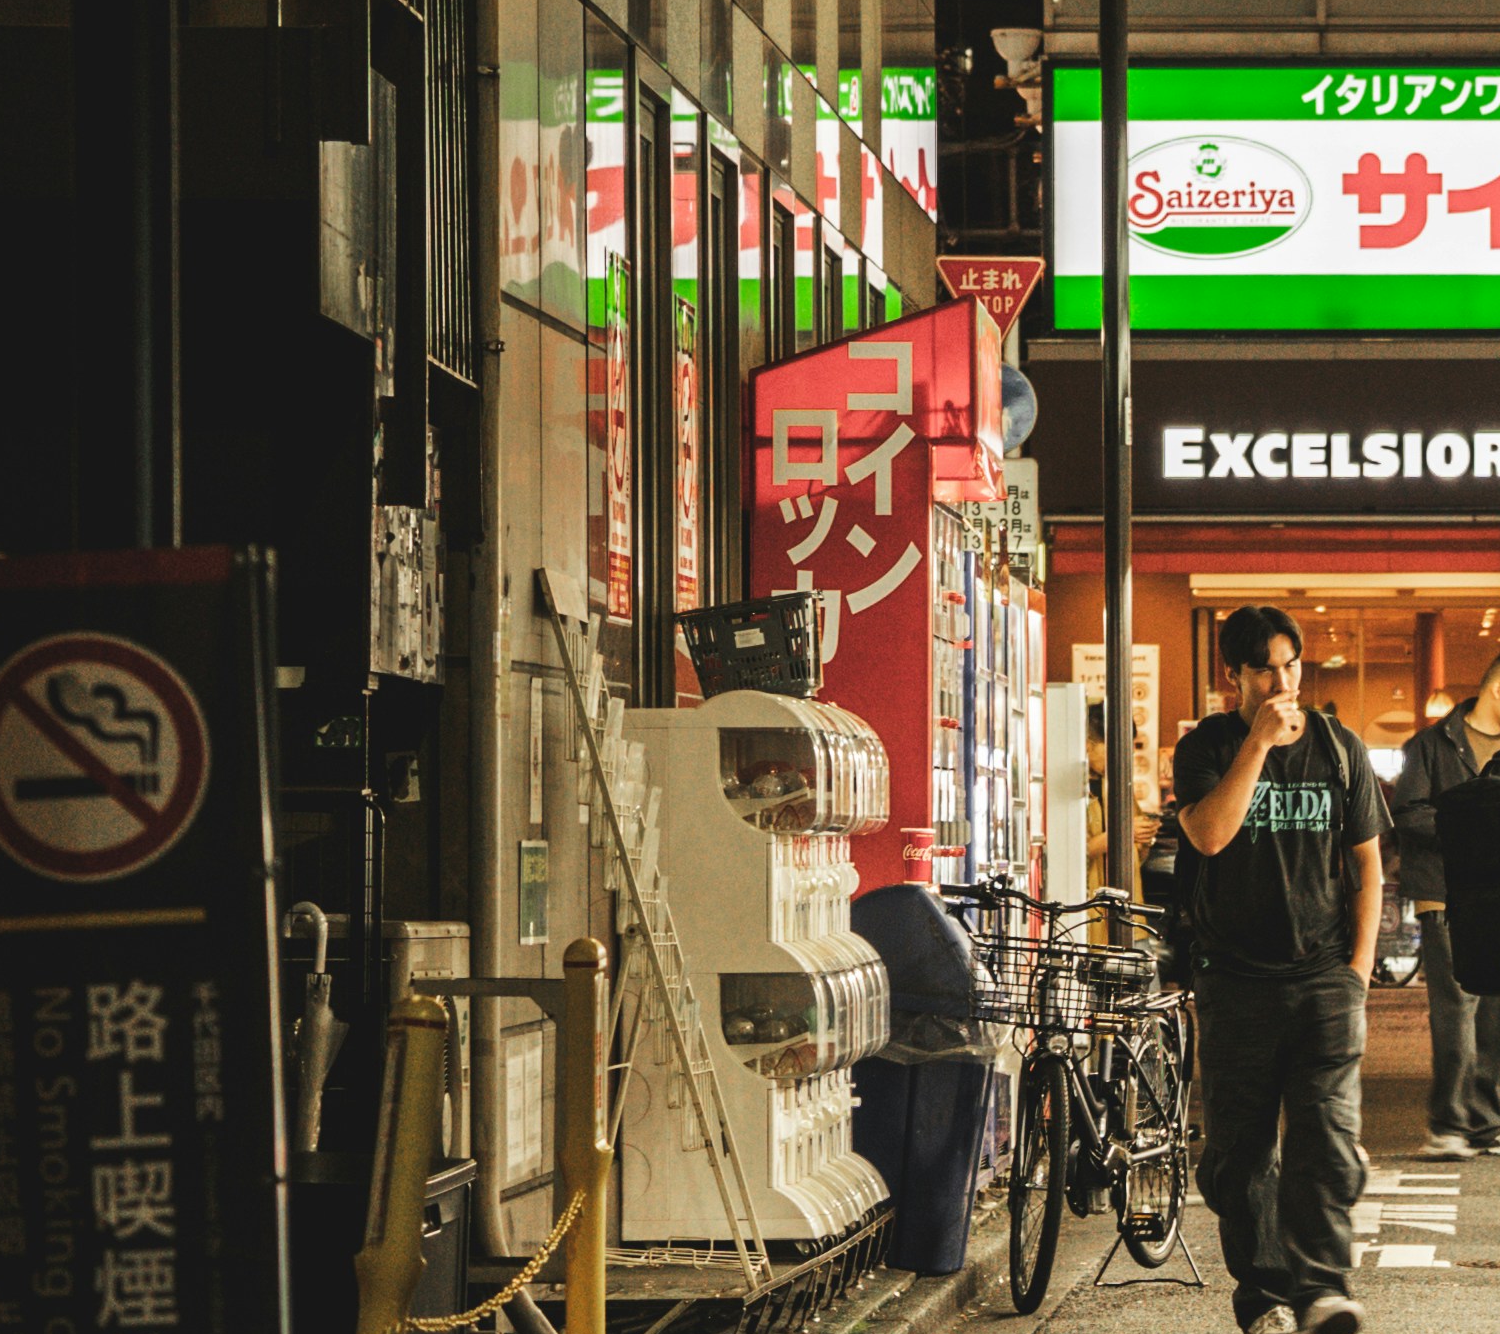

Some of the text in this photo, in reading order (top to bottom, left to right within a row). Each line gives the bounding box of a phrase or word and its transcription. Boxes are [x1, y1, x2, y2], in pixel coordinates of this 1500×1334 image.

[1129, 170, 1296, 220] Saizeriya
[959, 268, 1022, 291] 止まれ
[846, 340, 922, 616] コイン
[32, 985, 73, 1059] No
[32, 1075, 86, 1298] Smoking
